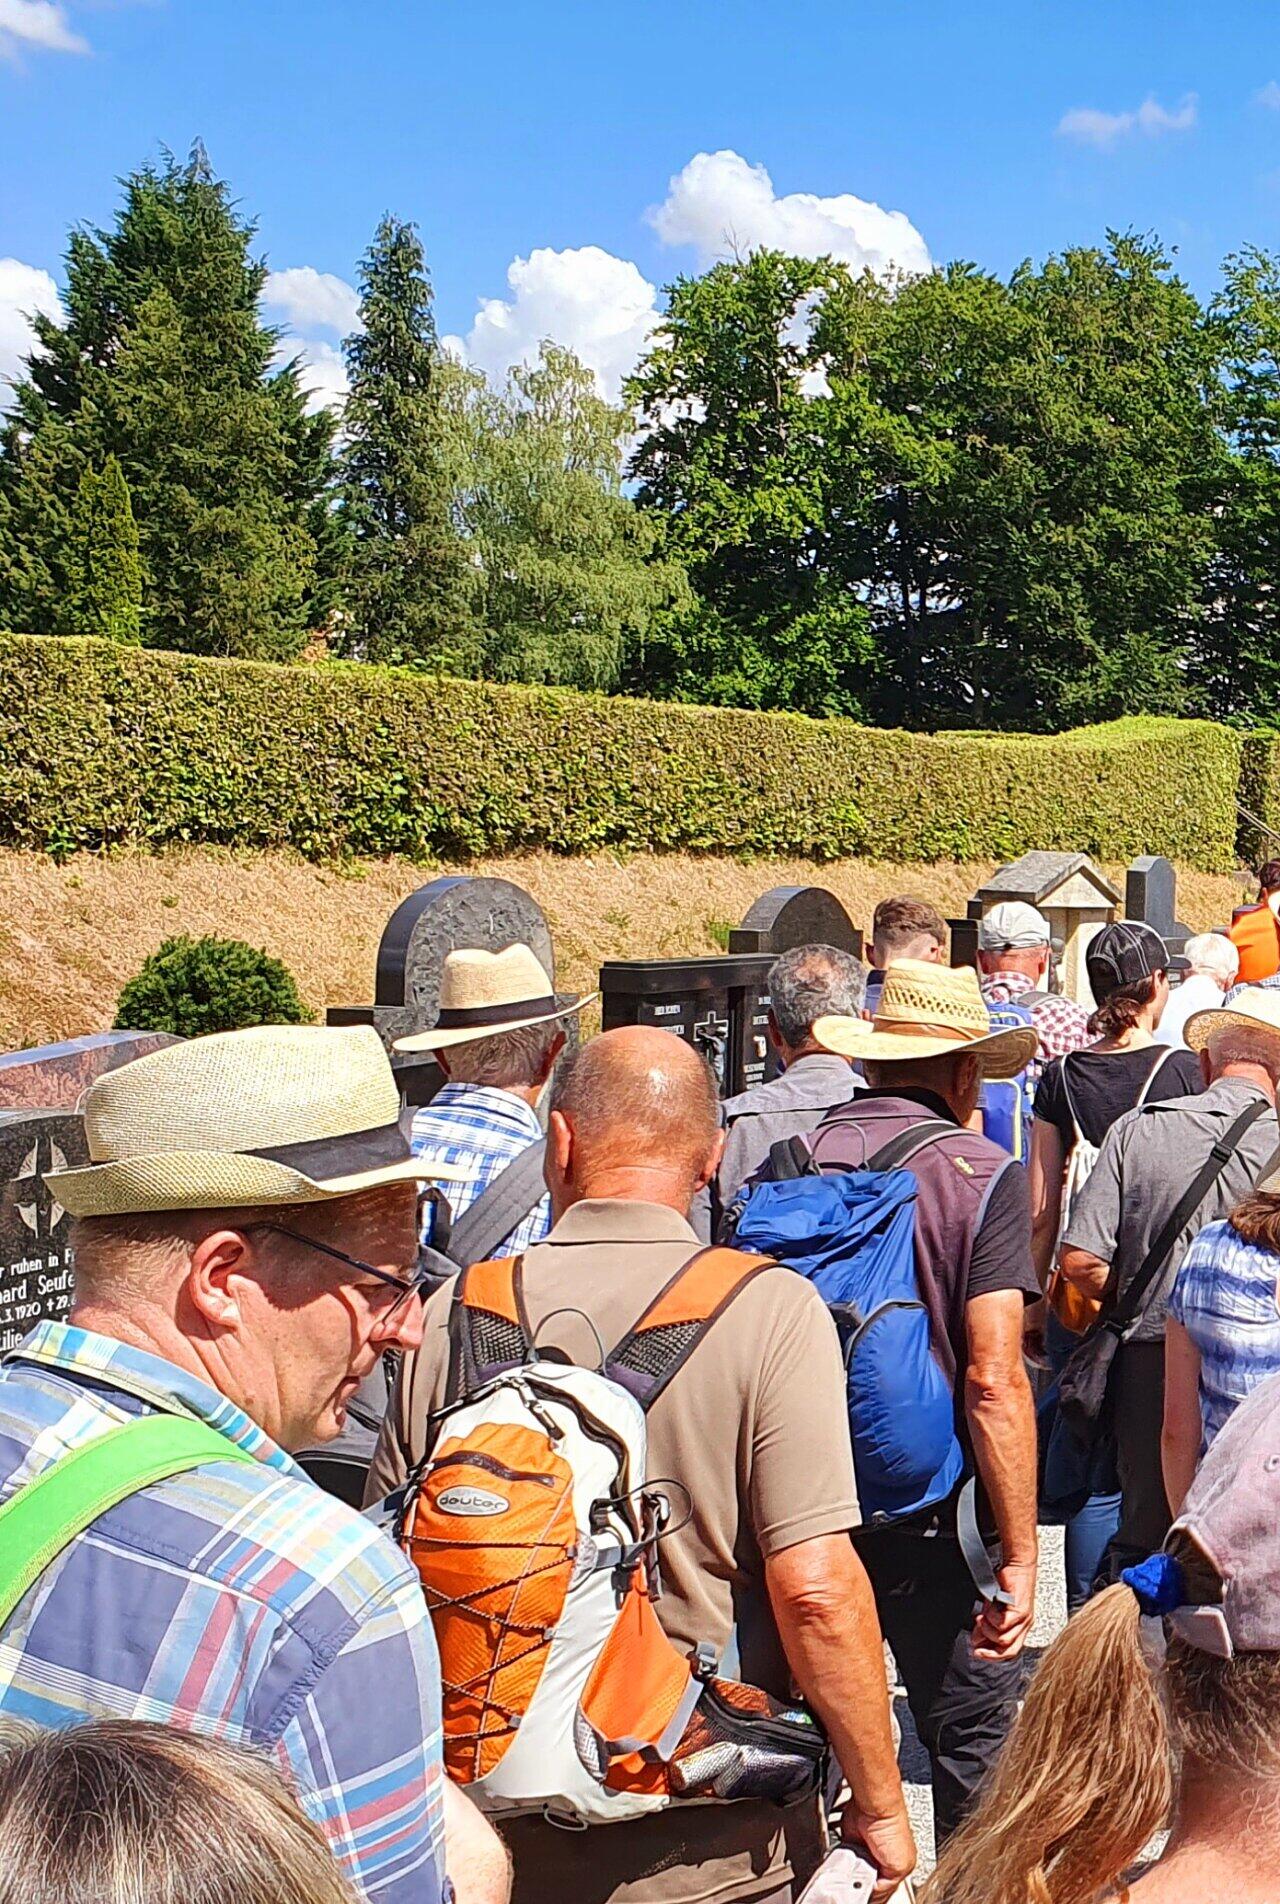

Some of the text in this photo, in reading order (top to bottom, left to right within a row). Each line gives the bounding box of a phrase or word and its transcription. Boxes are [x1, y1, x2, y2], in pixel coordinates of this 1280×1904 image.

[10, 1257, 42, 1276] ruhen
[48, 1252, 59, 1267] in
[439, 1495, 506, 1509] deuter
